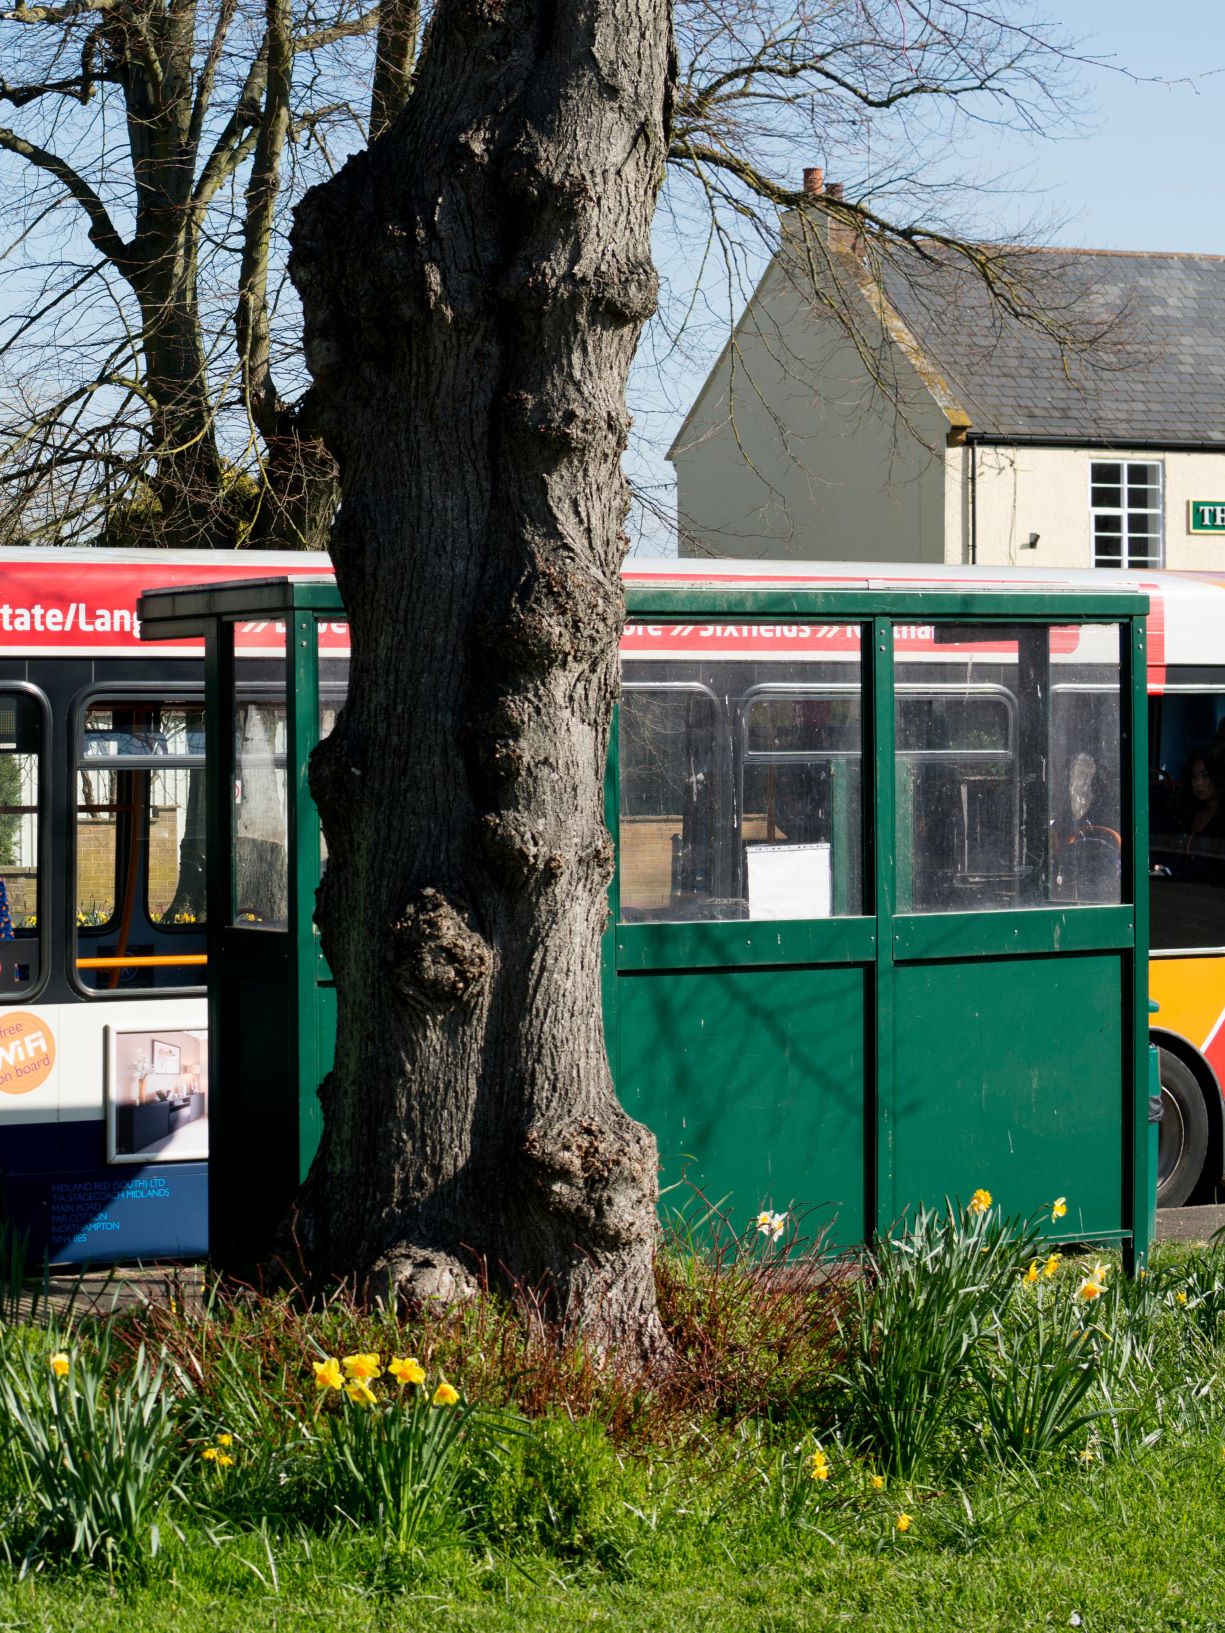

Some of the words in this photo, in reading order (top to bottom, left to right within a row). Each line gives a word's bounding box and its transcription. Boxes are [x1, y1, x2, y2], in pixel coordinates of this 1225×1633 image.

[14, 1052, 51, 1077] board
[51, 1182, 93, 1193] MIDLAND
[94, 1181, 111, 1190] RED
[112, 1179, 147, 1190] (SOUTH)
[150, 1178, 166, 1187] LTD
[68, 1190, 125, 1201] STAGECOACH
[126, 1188, 170, 1199] MIDLANDS
[77, 1202, 102, 1211] ROAD
[69, 1212, 108, 1222] COTTON
[51, 1221, 120, 1233] NORTHAMPTON
